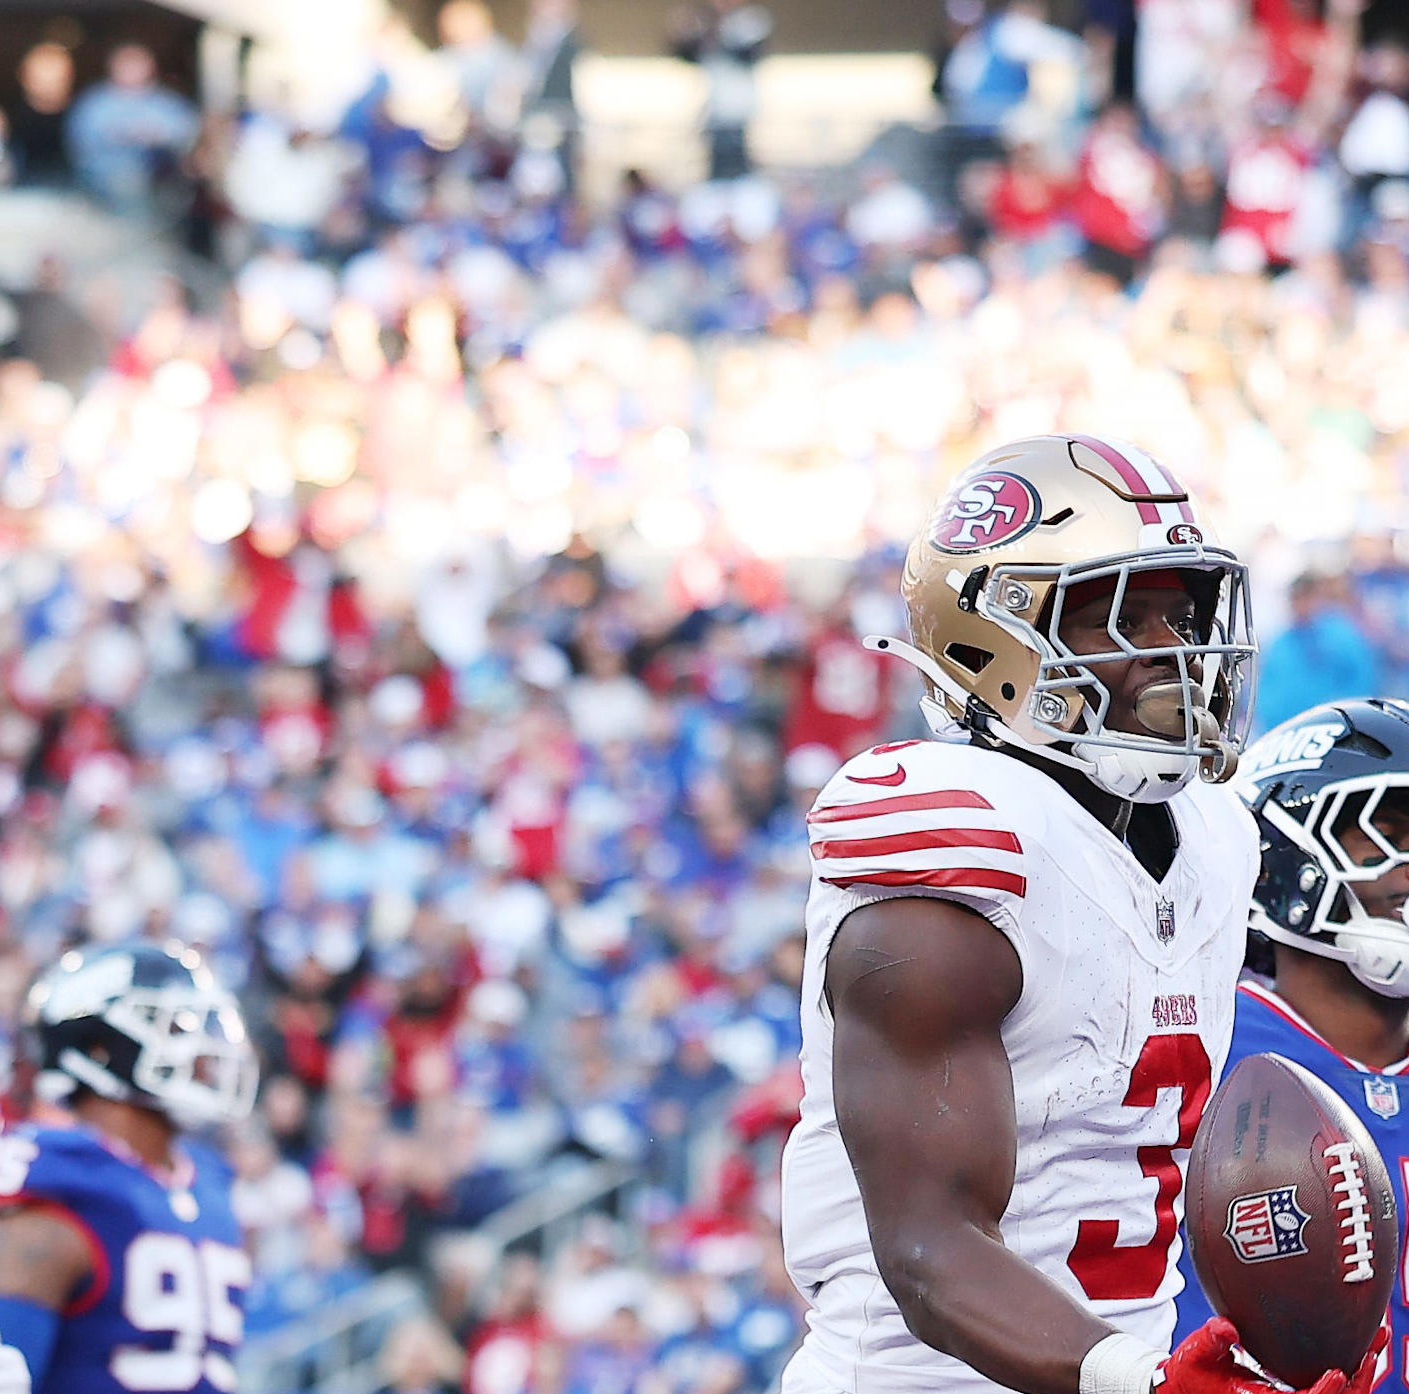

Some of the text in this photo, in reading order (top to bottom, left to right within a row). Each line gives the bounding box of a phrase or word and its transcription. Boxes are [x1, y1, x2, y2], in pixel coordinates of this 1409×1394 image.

[947, 480, 1016, 544] SF
[1067, 1033, 1212, 1301] 3
[1234, 1199, 1274, 1255] NFL
[108, 1229, 252, 1393] 95
